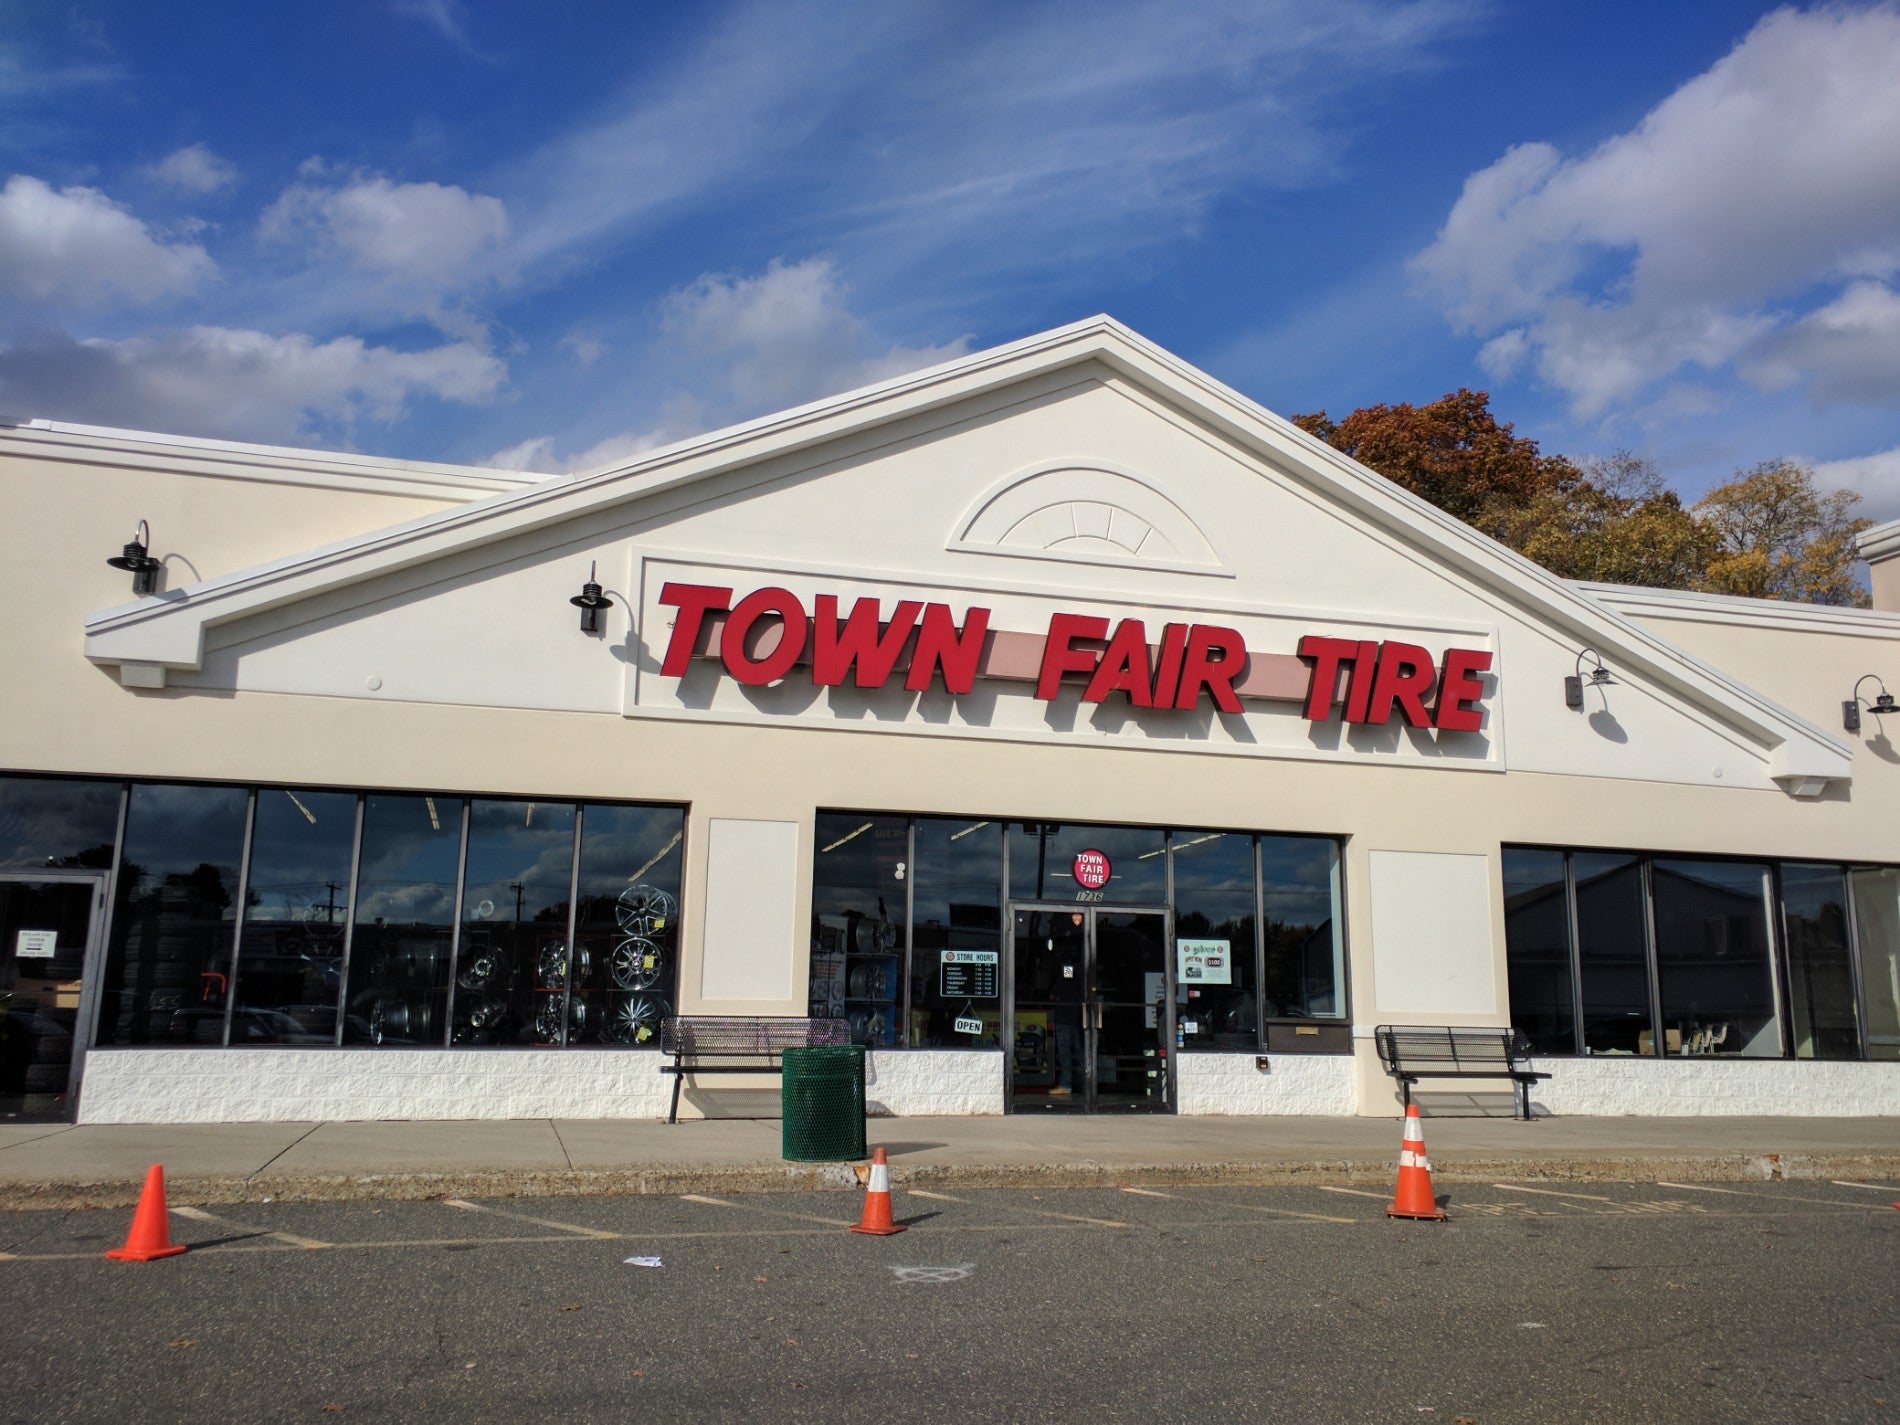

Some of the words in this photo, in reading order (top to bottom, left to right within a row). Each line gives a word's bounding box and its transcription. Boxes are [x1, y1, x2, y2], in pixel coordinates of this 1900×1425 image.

[659, 581, 992, 695] TOWN
[1034, 612, 1247, 715] FAIR
[1297, 634, 1494, 733] TIRE
[1077, 854, 1103, 864] TOWN
[1080, 864, 1103, 874] FAIR
[1083, 874, 1104, 884] TIRE
[1078, 892, 1102, 901] 1736
[956, 953, 974, 961] STORE
[976, 954, 994, 962] HOURS
[956, 1020, 981, 1032] OPEN
